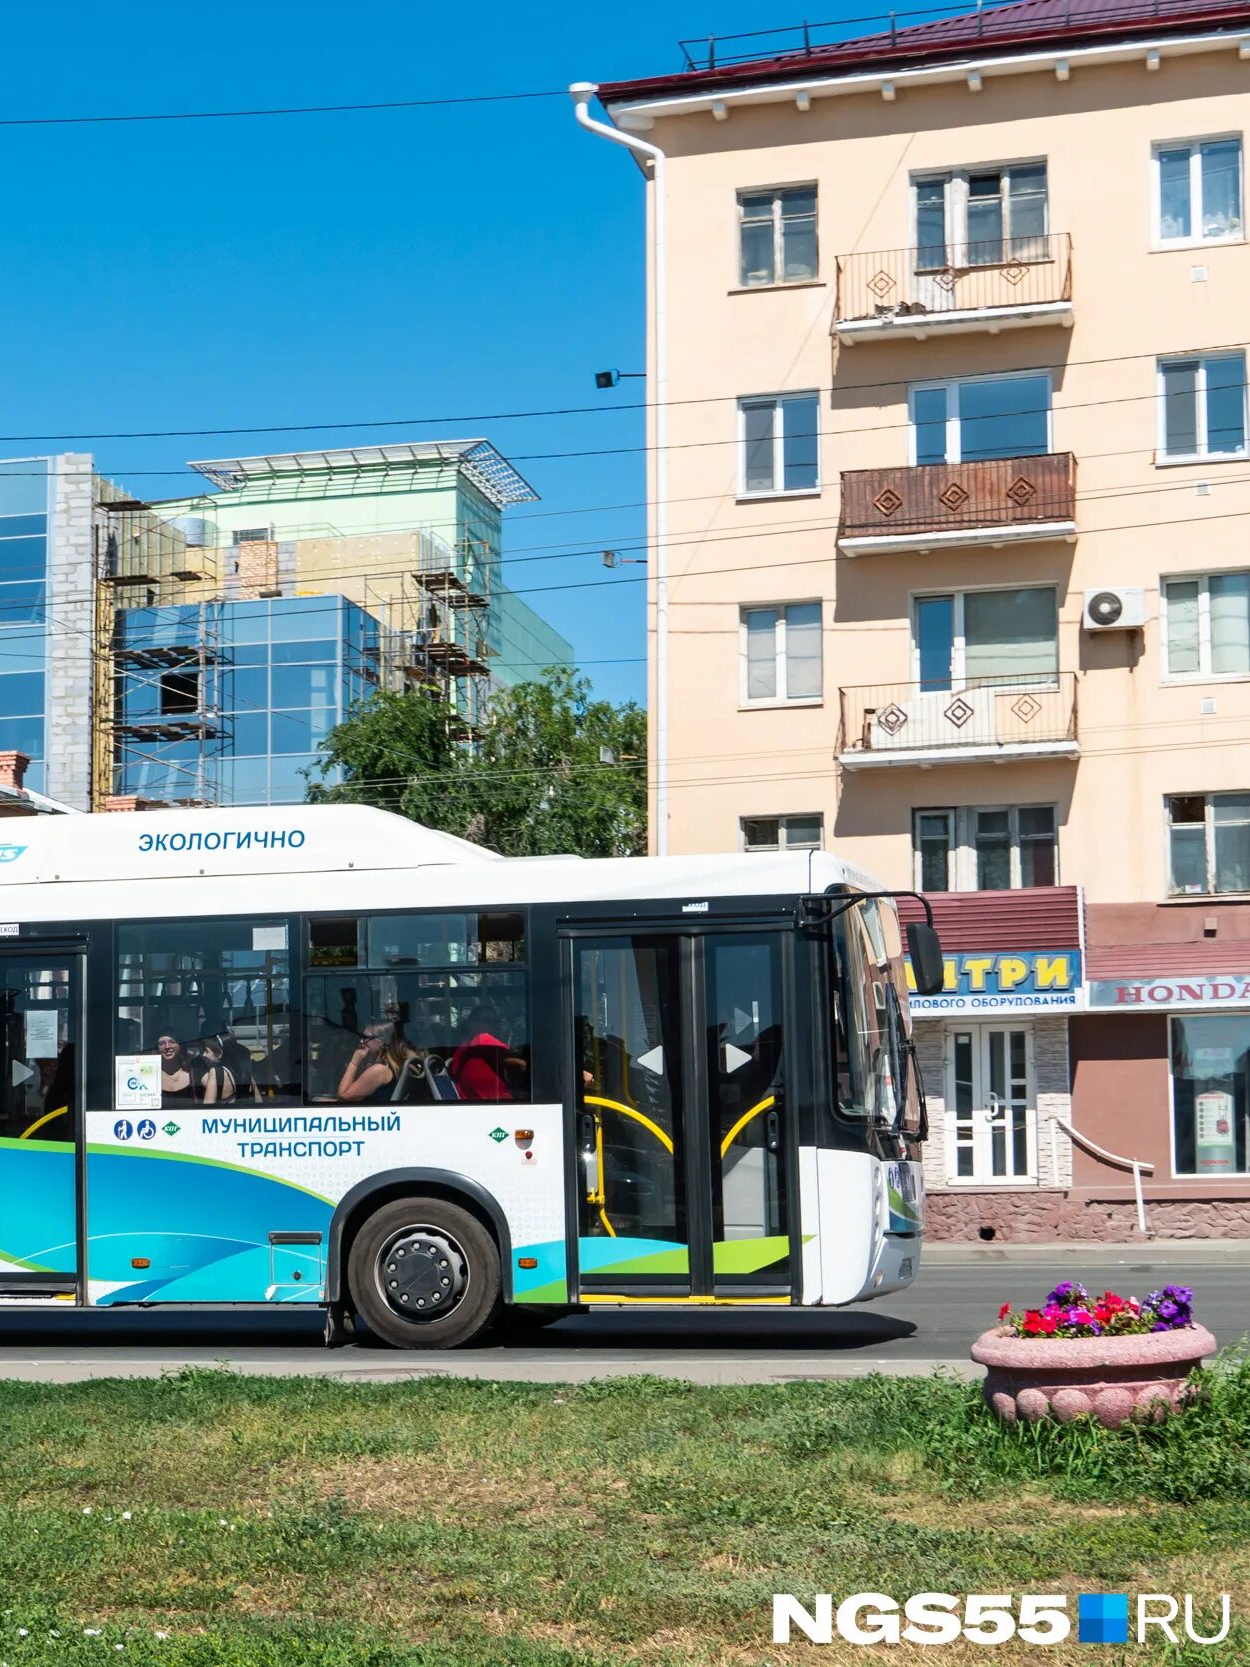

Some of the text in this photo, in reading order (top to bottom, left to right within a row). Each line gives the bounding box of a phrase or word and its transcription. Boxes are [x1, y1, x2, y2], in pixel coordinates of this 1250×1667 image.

[138, 829, 306, 852] ЭКОЛОГИЧНО
[904, 954, 1072, 994] ТРИ
[202, 1111, 401, 1134] МУНИЦИПАЛЬНЫЙ
[237, 1141, 365, 1157] ТРАНСПОРТ
